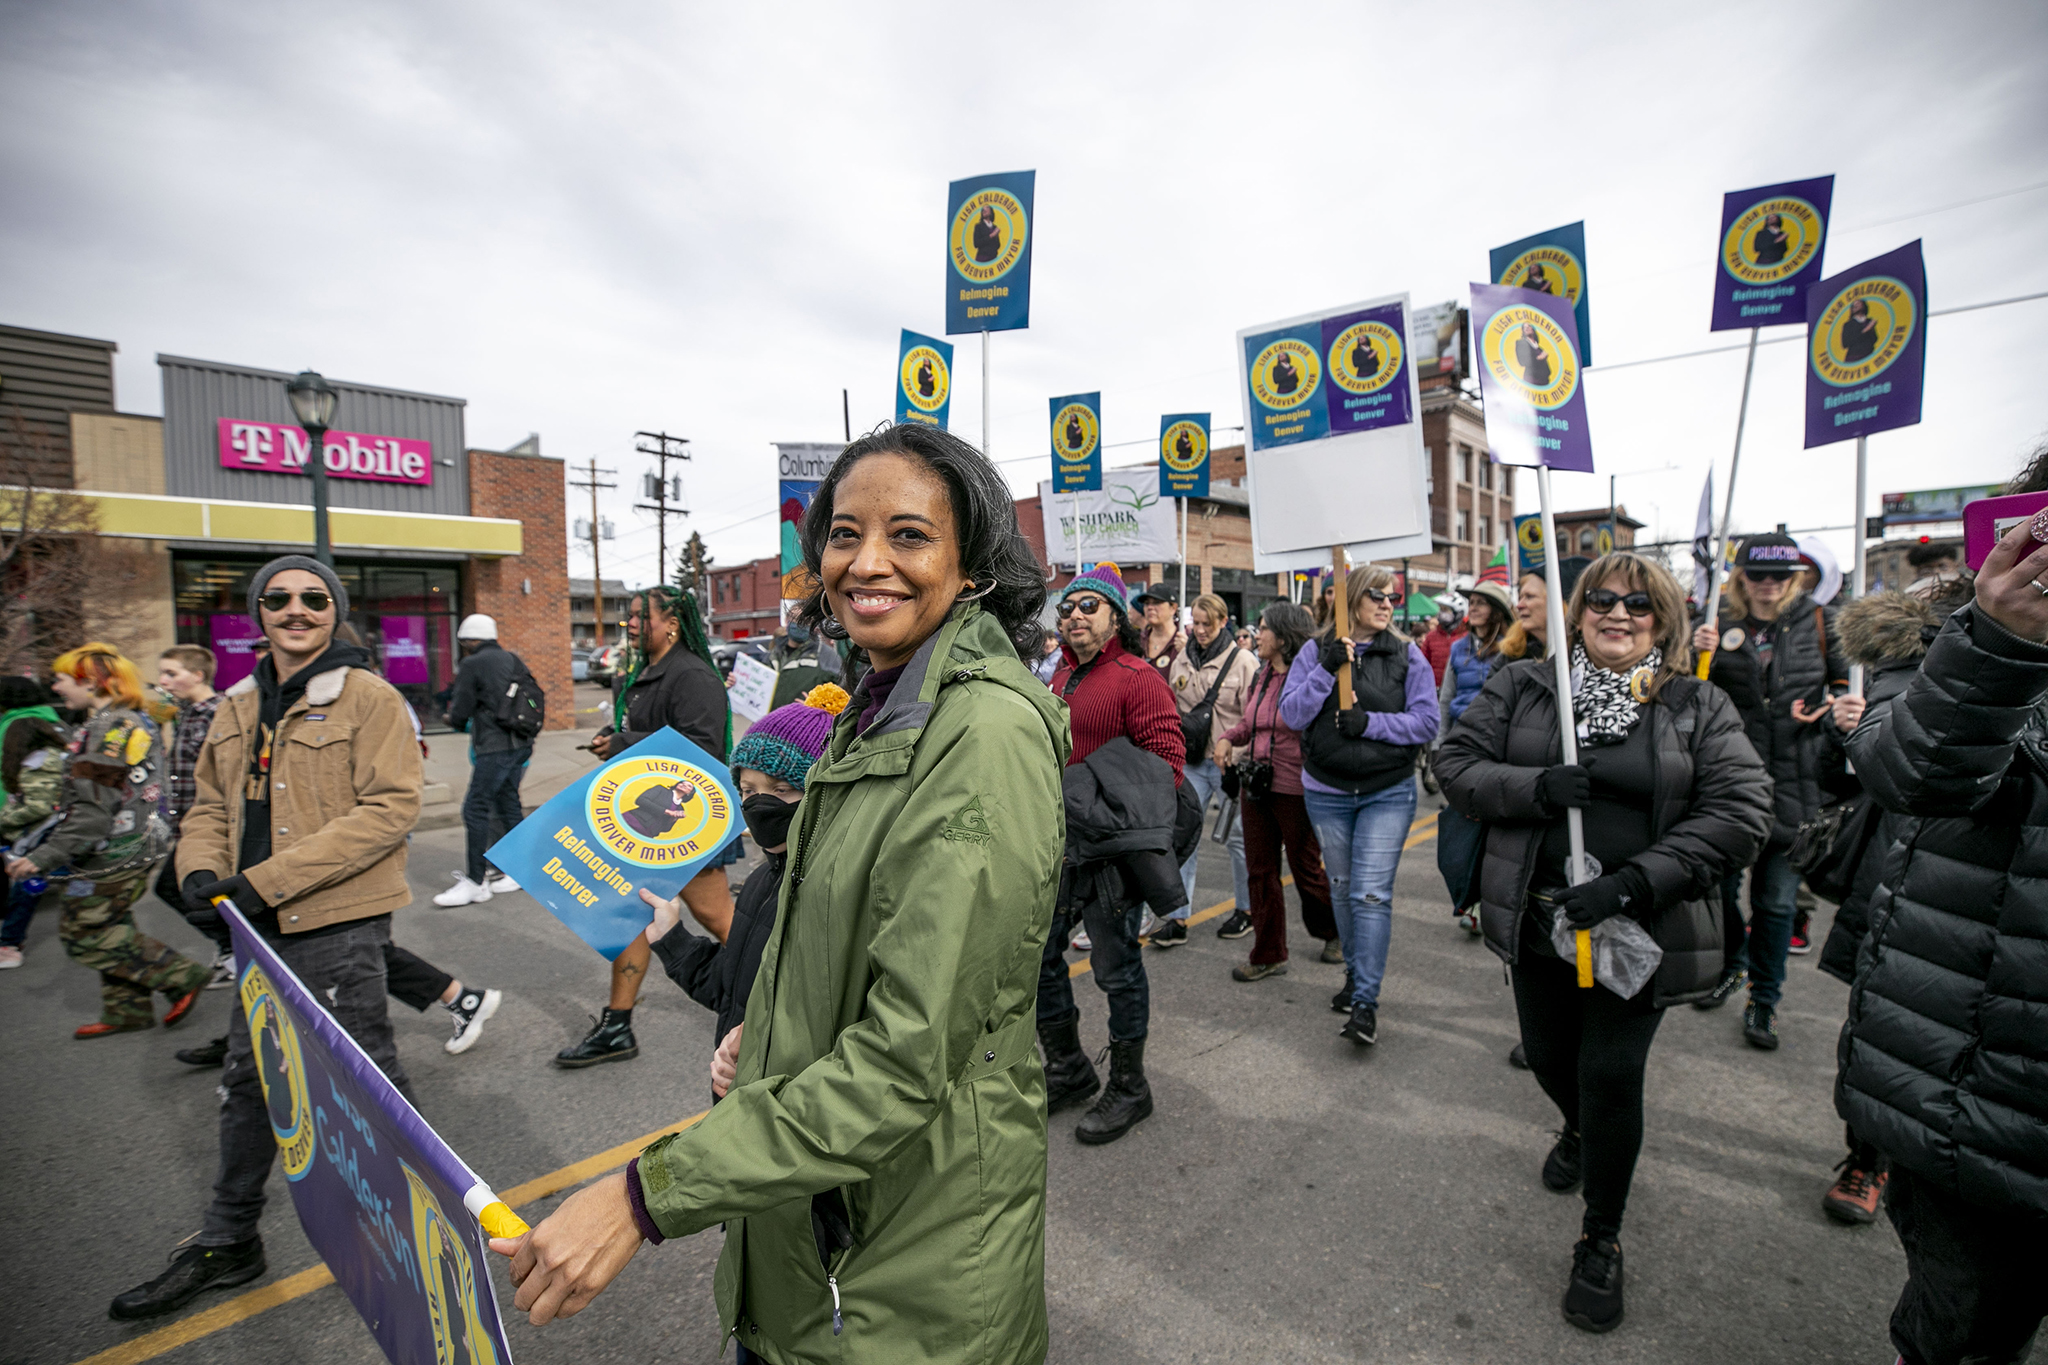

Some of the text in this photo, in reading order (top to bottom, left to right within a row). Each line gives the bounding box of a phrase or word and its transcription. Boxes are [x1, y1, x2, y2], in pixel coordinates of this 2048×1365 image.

[960, 203, 977, 222] LISA
[1738, 208, 1759, 231] LISA
[955, 239, 1021, 278] FOR DENVER MAYOR
[1730, 242, 1813, 280] FOR DENVER MAYOR
[960, 285, 1009, 301] ReImagine
[967, 306, 999, 318] Denver
[1740, 302, 1783, 317] Denver
[1824, 299, 1845, 326] LISA
[1493, 314, 1514, 335] LISA
[1259, 350, 1273, 367] LISA
[1818, 325, 1906, 380] FOR DENVER MAYOR
[1257, 373, 1316, 407] FOR DENVER MAYOR
[1335, 367, 1347, 381] FOR
[1346, 380, 1377, 391] DENVER
[1493, 359, 1510, 381] FOR
[1551, 368, 1573, 402] MAYOR
[1344, 393, 1393, 410] ReImagine
[1824, 381, 1892, 410] ReImagine
[1265, 409, 1311, 425] ReImagine
[1353, 408, 1386, 422] Denver
[1834, 405, 1879, 426] Denver
[1274, 424, 1304, 437] Denver
[280, 428, 426, 480] Mobile
[1531, 435, 1562, 451] enver
[1063, 524, 1097, 537] UNTED
[1100, 521, 1139, 533] CHURCH
[645, 762, 726, 820] LISA CALDERÓN
[596, 779, 700, 861] FOR DENVER MAYOR
[943, 829, 991, 847] GERRY
[553, 825, 633, 897] ReImagine
[542, 857, 599, 908] Denver
[288, 1107, 311, 1168] DENVER
[316, 1106, 420, 1294] Calderón
